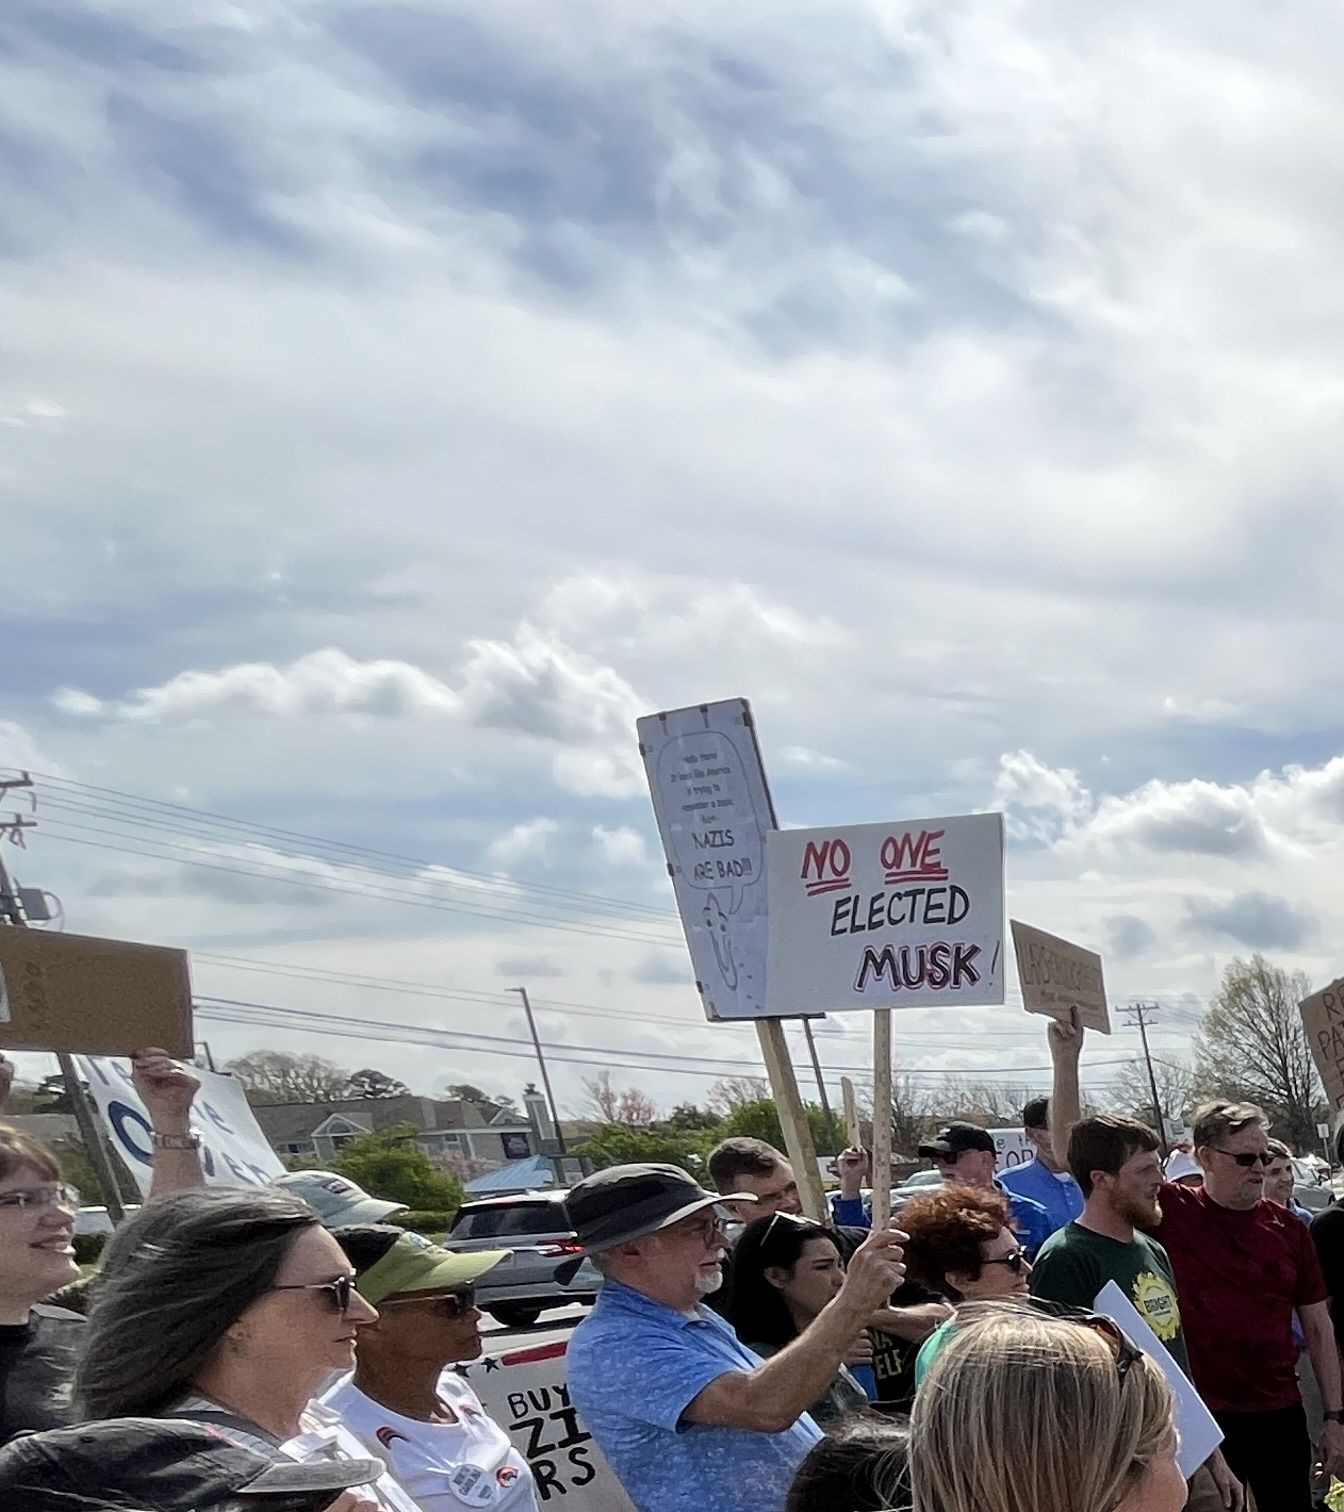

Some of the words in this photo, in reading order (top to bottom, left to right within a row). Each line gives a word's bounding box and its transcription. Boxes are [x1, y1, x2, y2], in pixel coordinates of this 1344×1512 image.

[692, 829, 735, 850] NAZIS
[801, 838, 851, 880] NO
[880, 829, 946, 870] ONE
[694, 861, 715, 881] ARE
[831, 884, 970, 936] ELECTED
[507, 1382, 572, 1420] BUY
